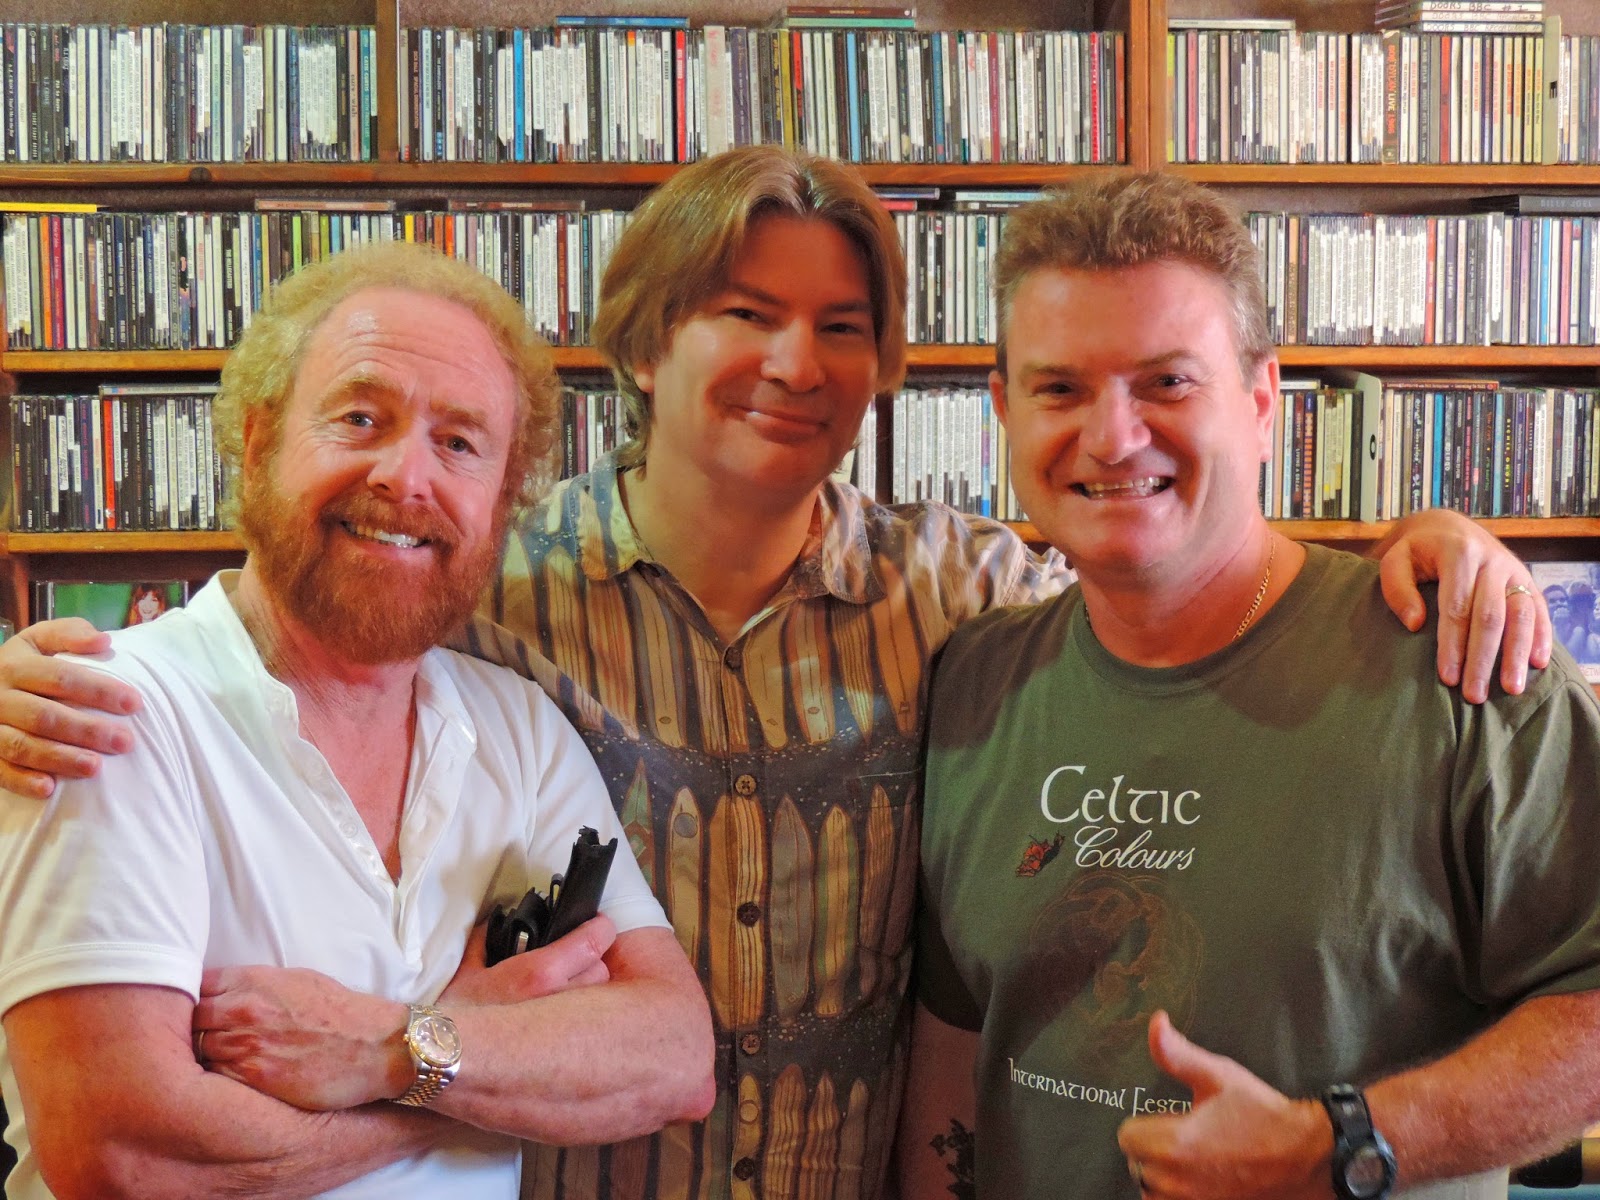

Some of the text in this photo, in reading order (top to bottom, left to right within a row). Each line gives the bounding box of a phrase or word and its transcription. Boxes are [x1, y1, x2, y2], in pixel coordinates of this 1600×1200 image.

[1469, 3, 1491, 11] BBC
[1388, 45, 1396, 62] BOB
[1388, 64, 1396, 91] DYLAN
[195, 402, 204, 434] STEVE
[1074, 825, 1195, 870] Colours
